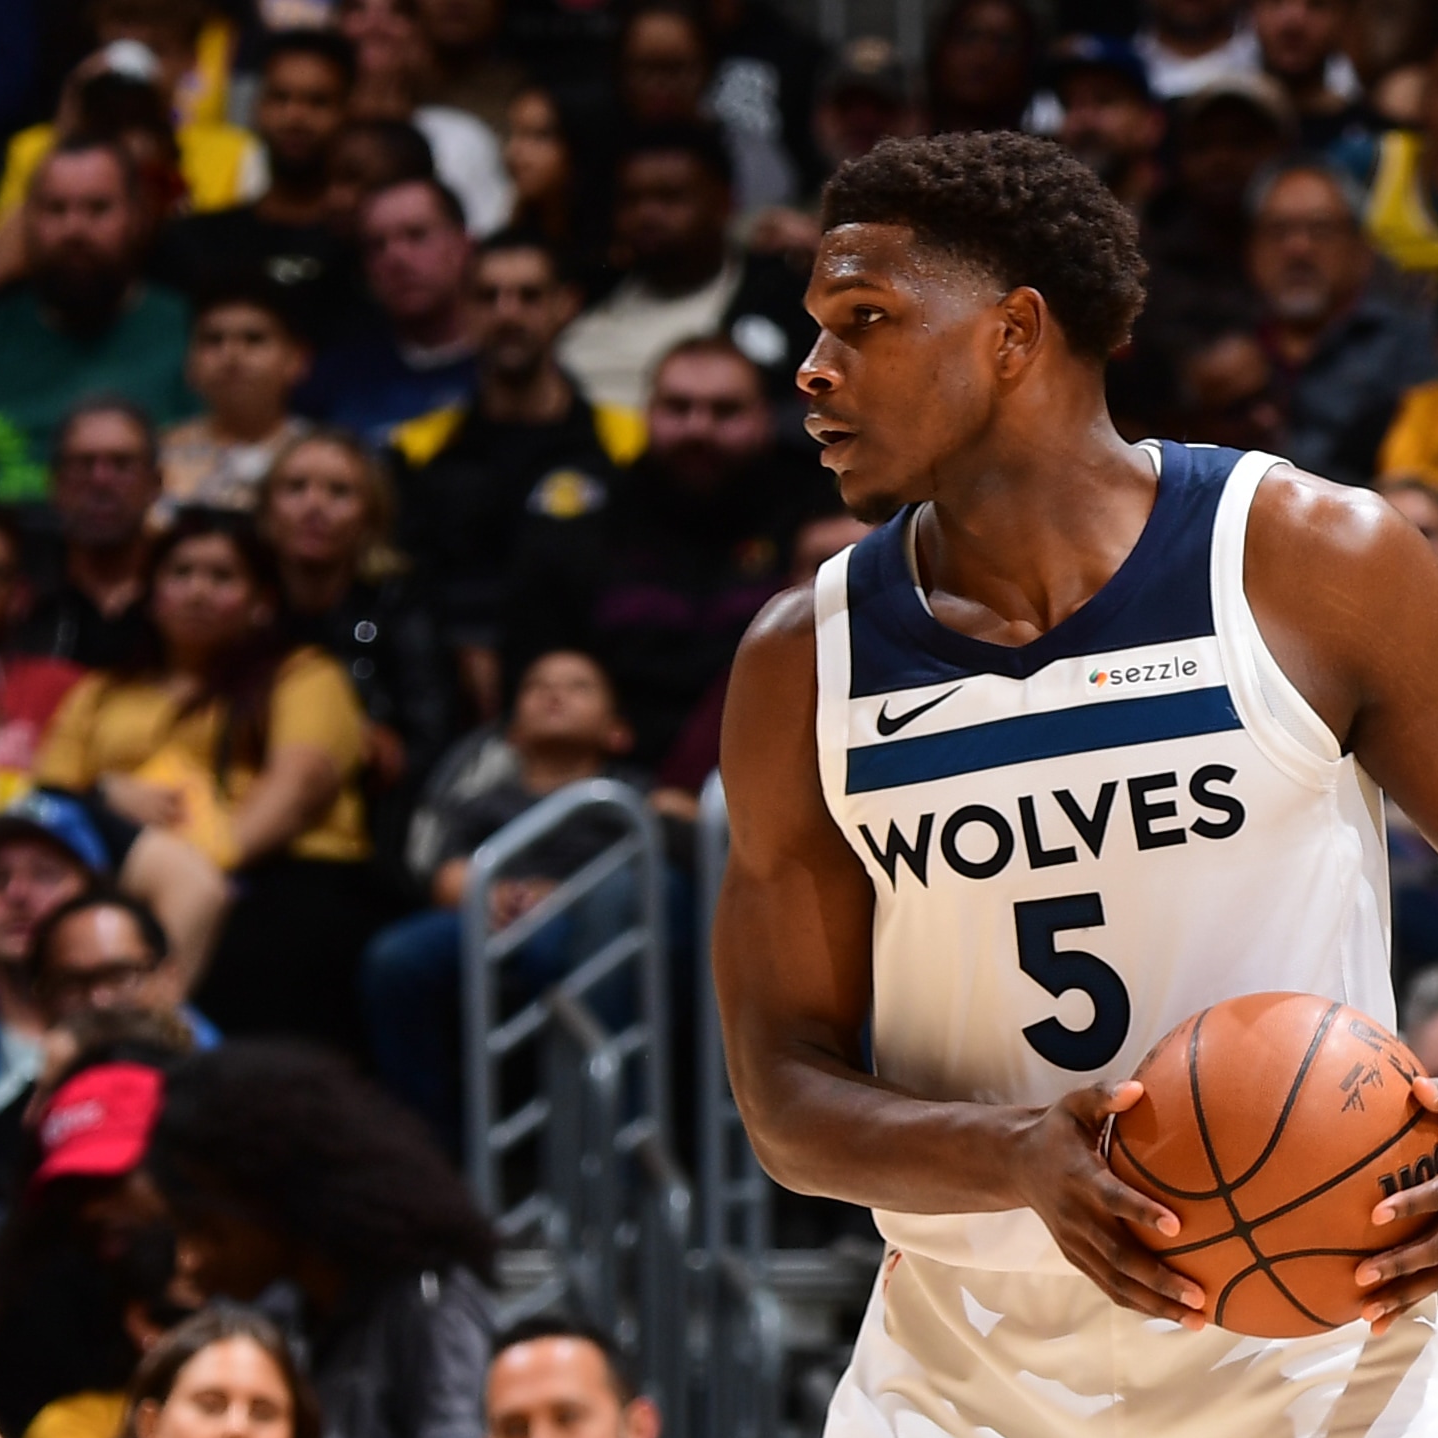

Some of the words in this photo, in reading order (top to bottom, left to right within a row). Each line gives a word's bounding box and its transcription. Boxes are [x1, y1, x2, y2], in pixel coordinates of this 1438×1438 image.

[1109, 655, 1198, 685] sezzle
[857, 763, 1246, 894] WOLVES
[1013, 891, 1132, 1072] 5
